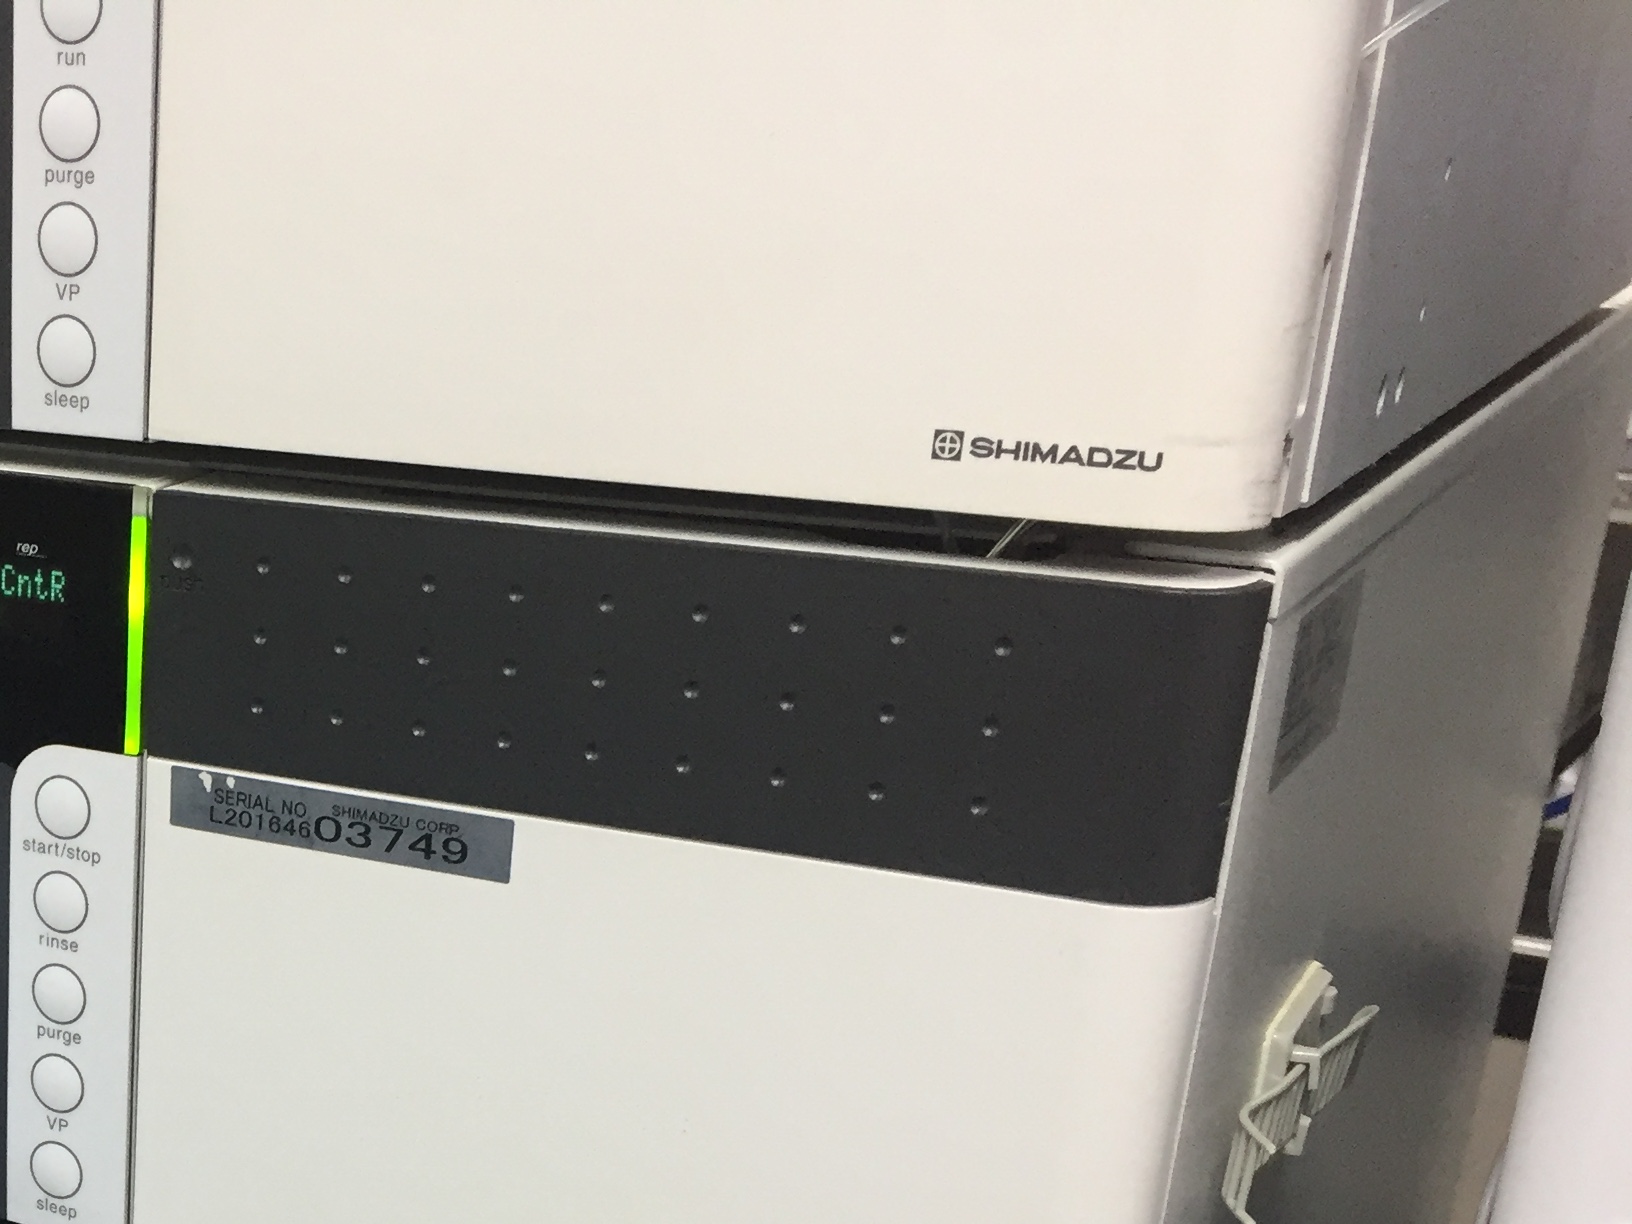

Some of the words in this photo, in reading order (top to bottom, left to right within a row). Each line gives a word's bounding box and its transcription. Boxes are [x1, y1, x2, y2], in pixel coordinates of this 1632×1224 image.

[57, 48, 86, 66] run
[44, 167, 95, 189] purge
[56, 283, 81, 301] VP
[44, 391, 90, 413] sleep
[969, 436, 1164, 472] SHIMADZU
[16, 541, 39, 557] rep
[214, 788, 275, 814] SERIAL
[331, 804, 410, 829] SHIMADZU
[22, 838, 101, 867] start/stop
[38, 932, 79, 952] rinse
[37, 1024, 82, 1046] purge
[46, 1116, 69, 1132] VP
[36, 1198, 77, 1220] sleep
